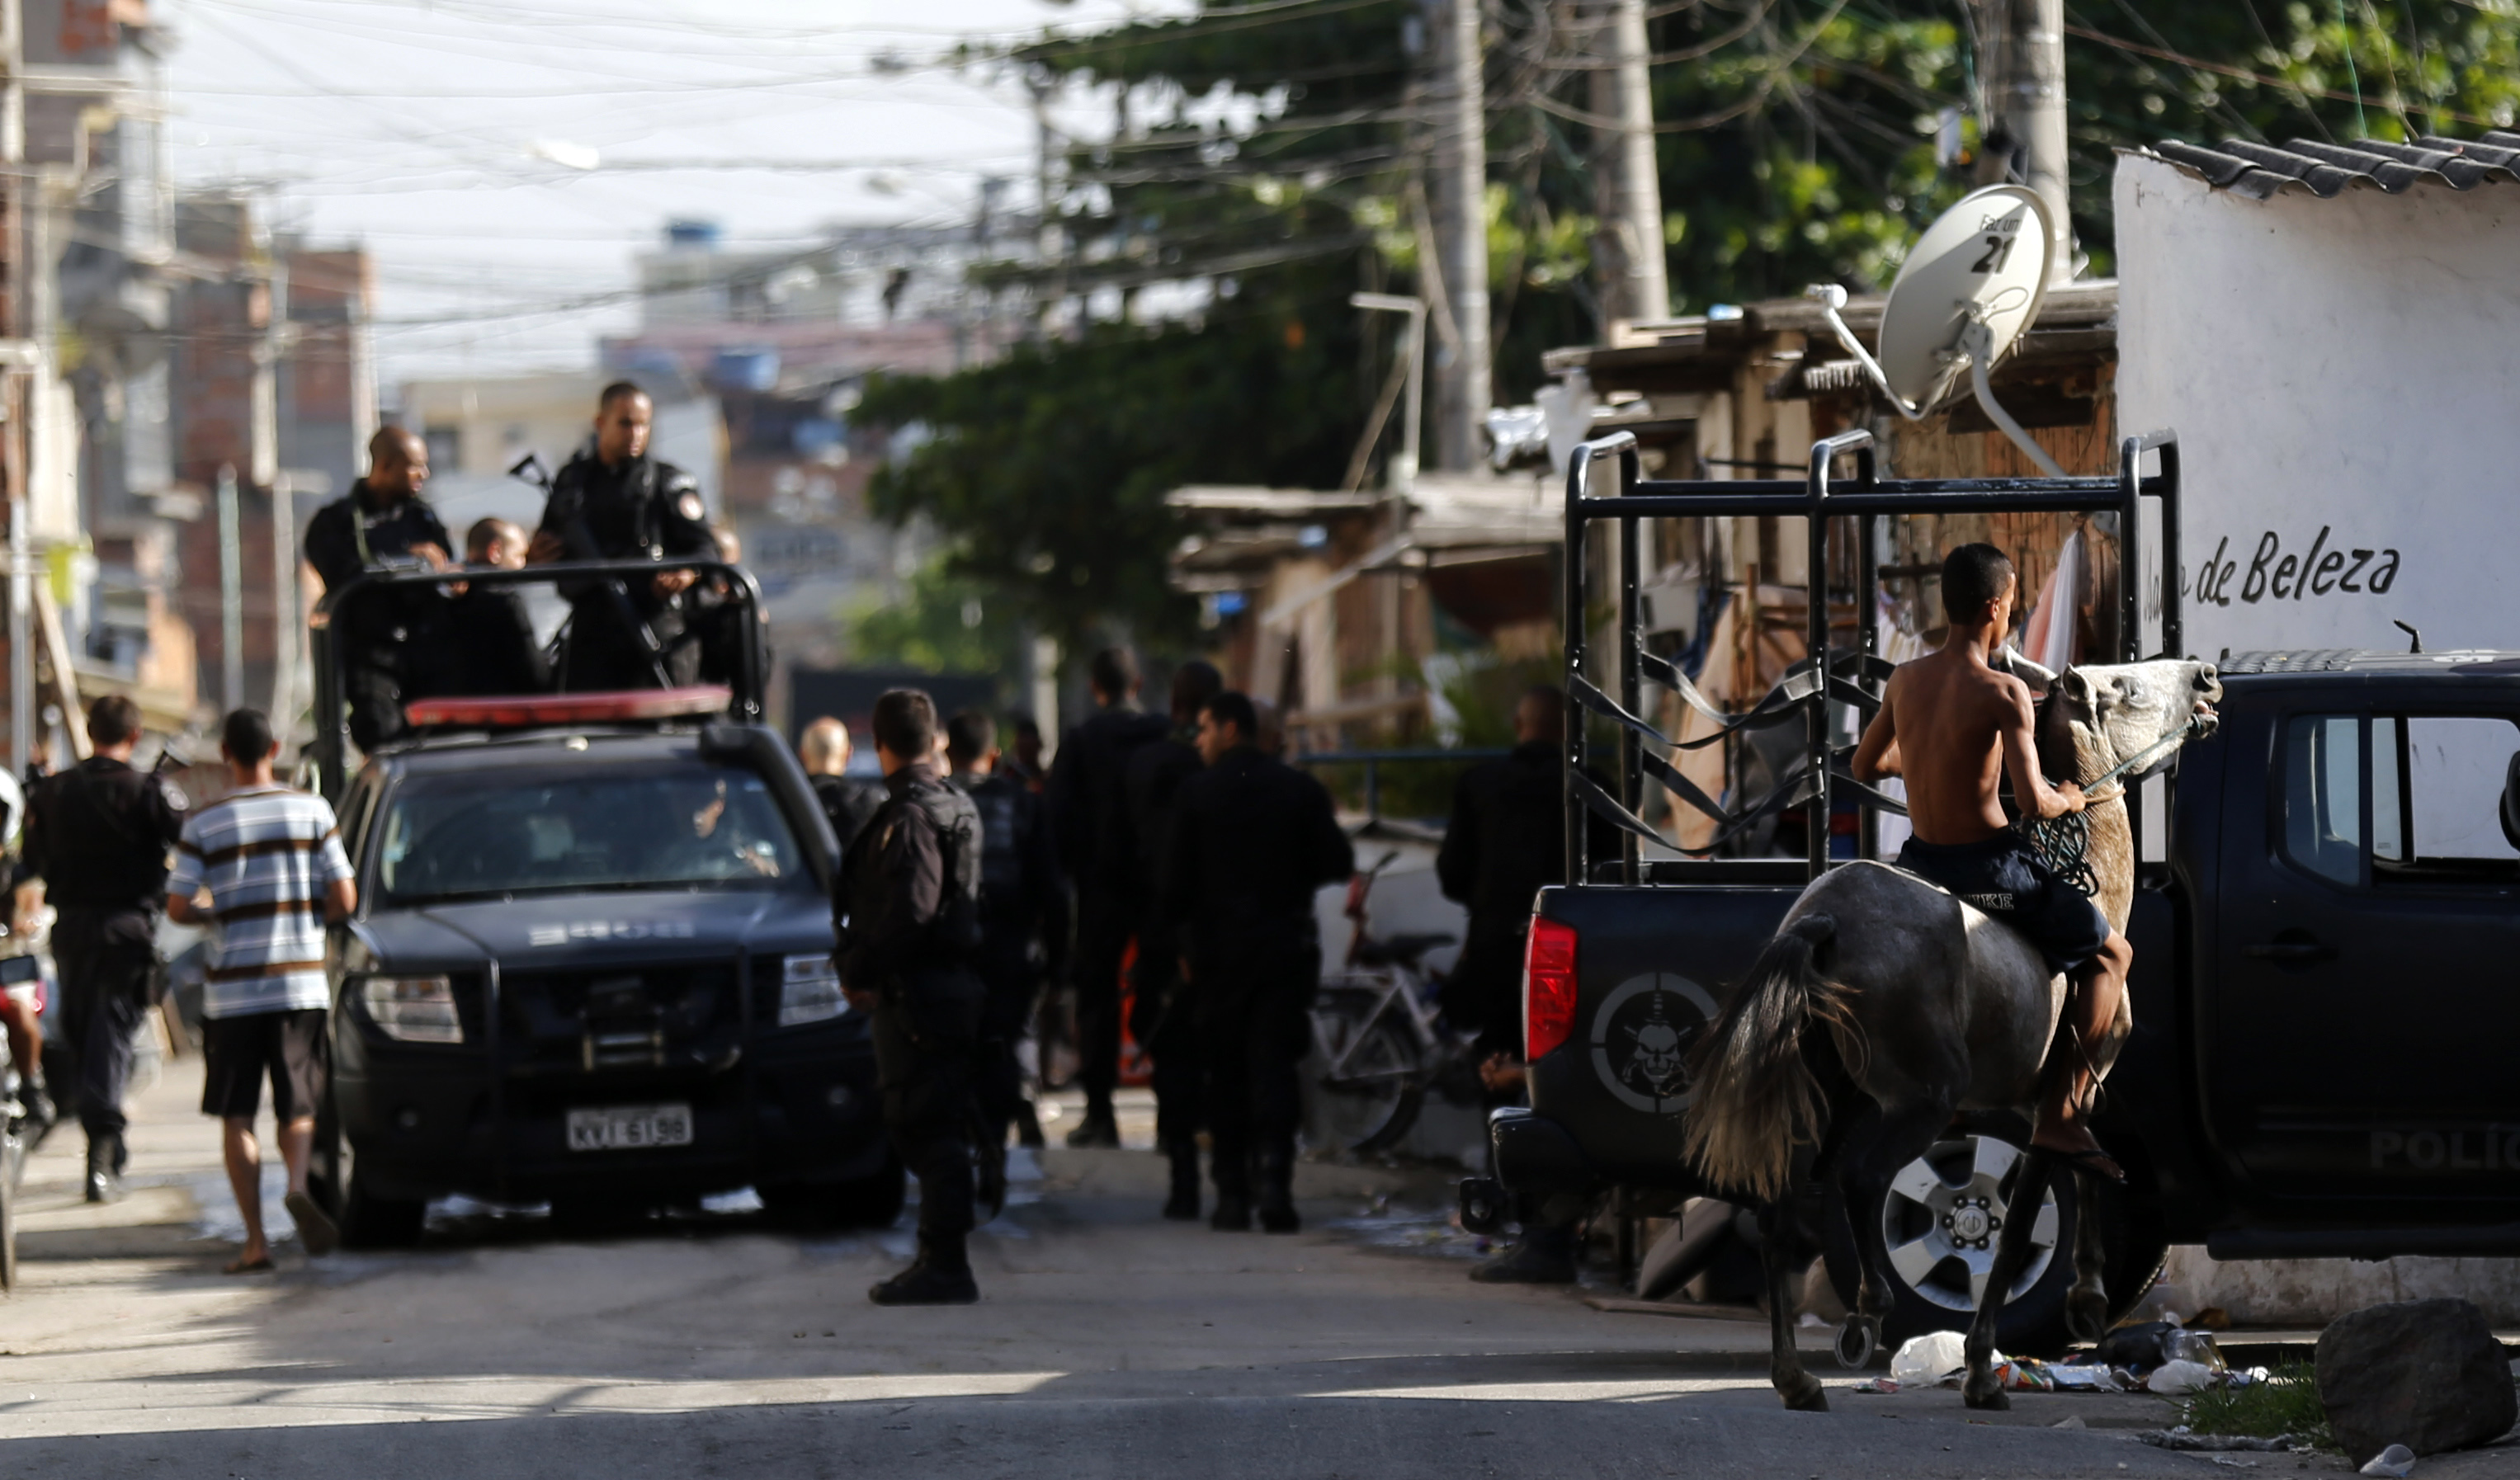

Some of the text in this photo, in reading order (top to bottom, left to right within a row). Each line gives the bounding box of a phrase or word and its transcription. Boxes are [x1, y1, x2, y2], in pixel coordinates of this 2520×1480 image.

[1970, 236, 2016, 274] 21
[2197, 536, 2237, 607] de
[2240, 525, 2401, 604] Beleza
[1964, 893, 2014, 910] IKE
